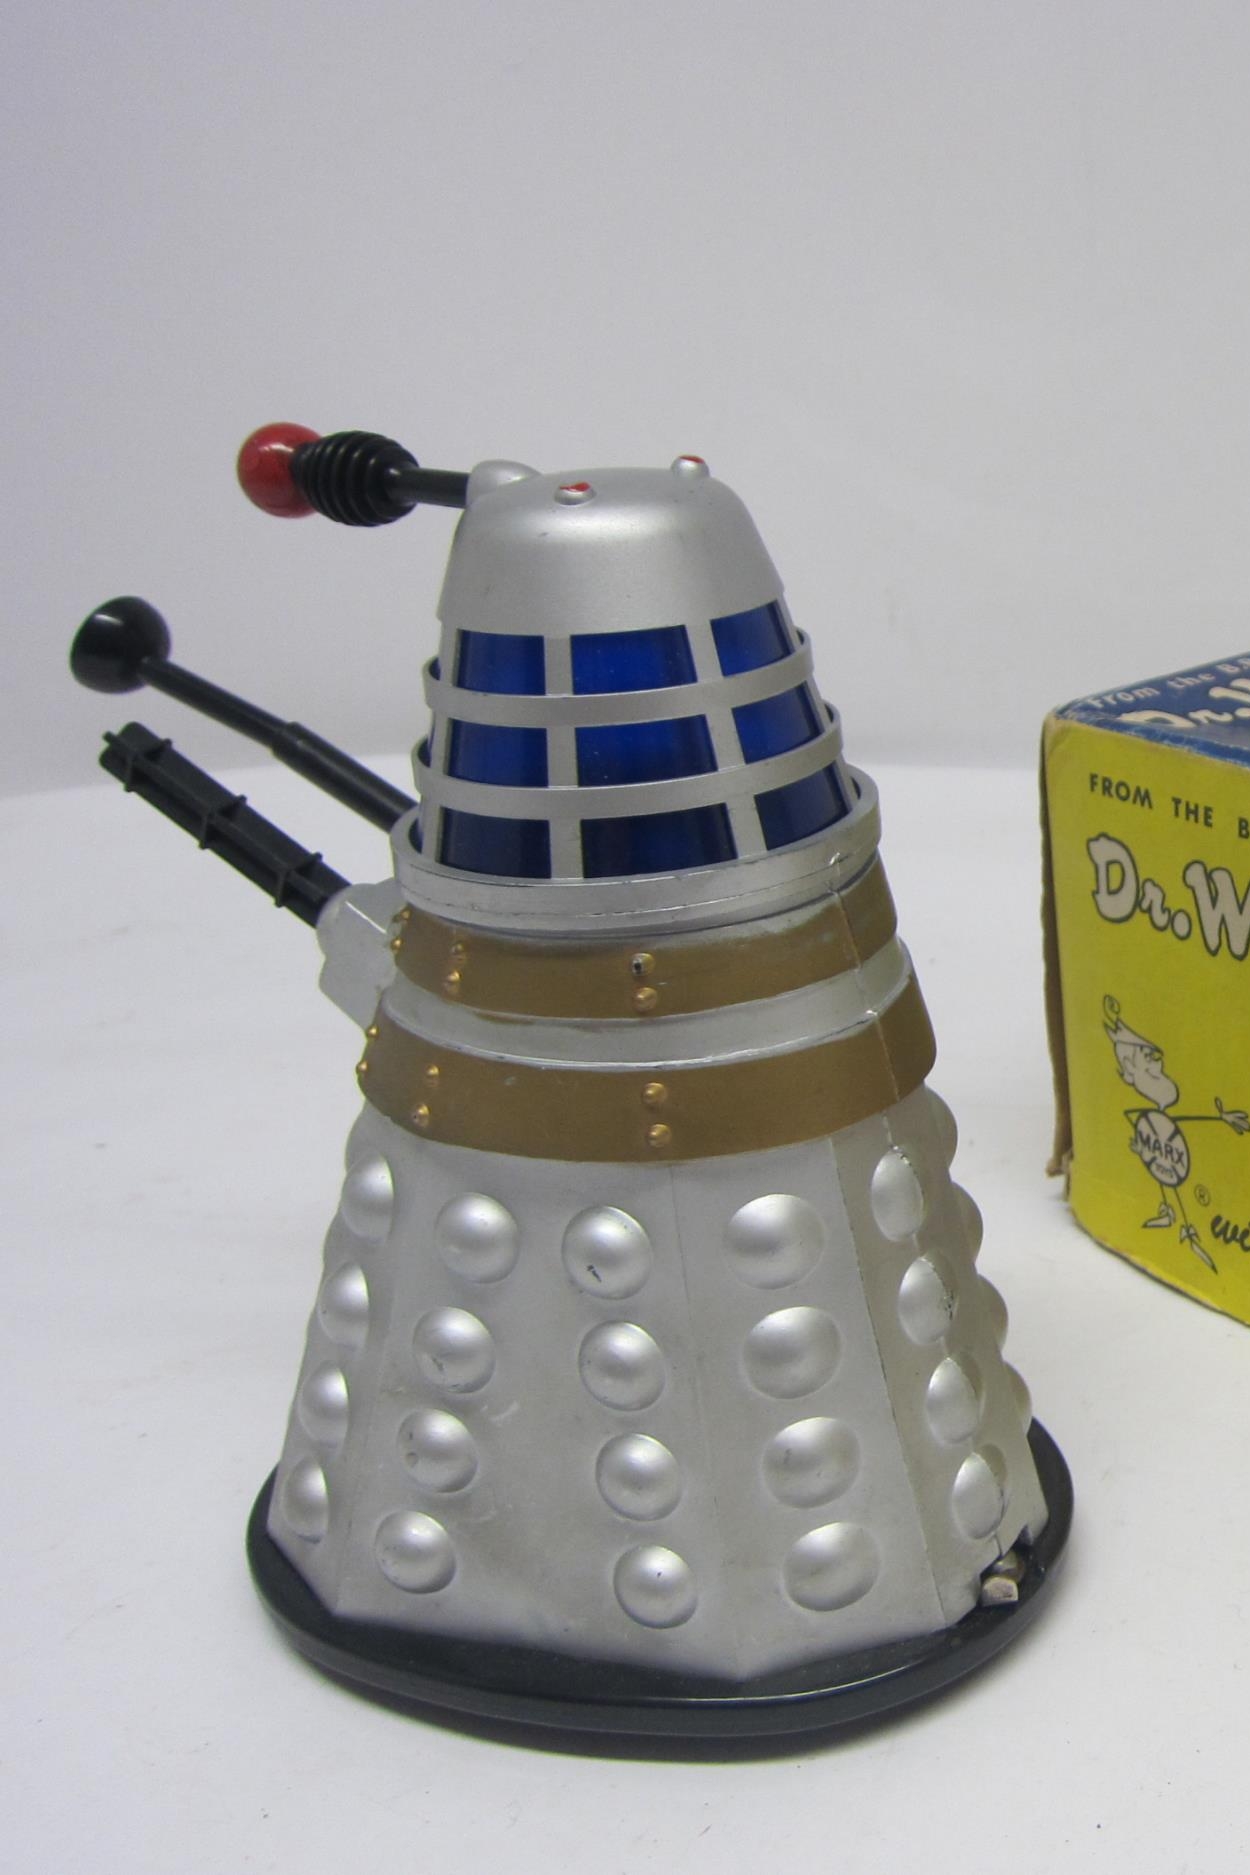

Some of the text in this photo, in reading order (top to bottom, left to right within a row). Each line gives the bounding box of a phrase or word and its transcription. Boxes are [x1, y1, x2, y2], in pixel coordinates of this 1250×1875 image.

[1087, 686, 1160, 709] From
[1167, 672, 1216, 689] the
[1089, 773, 1153, 809] FROM
[1171, 797, 1214, 828] THE
[1138, 1130, 1186, 1169] MARX
